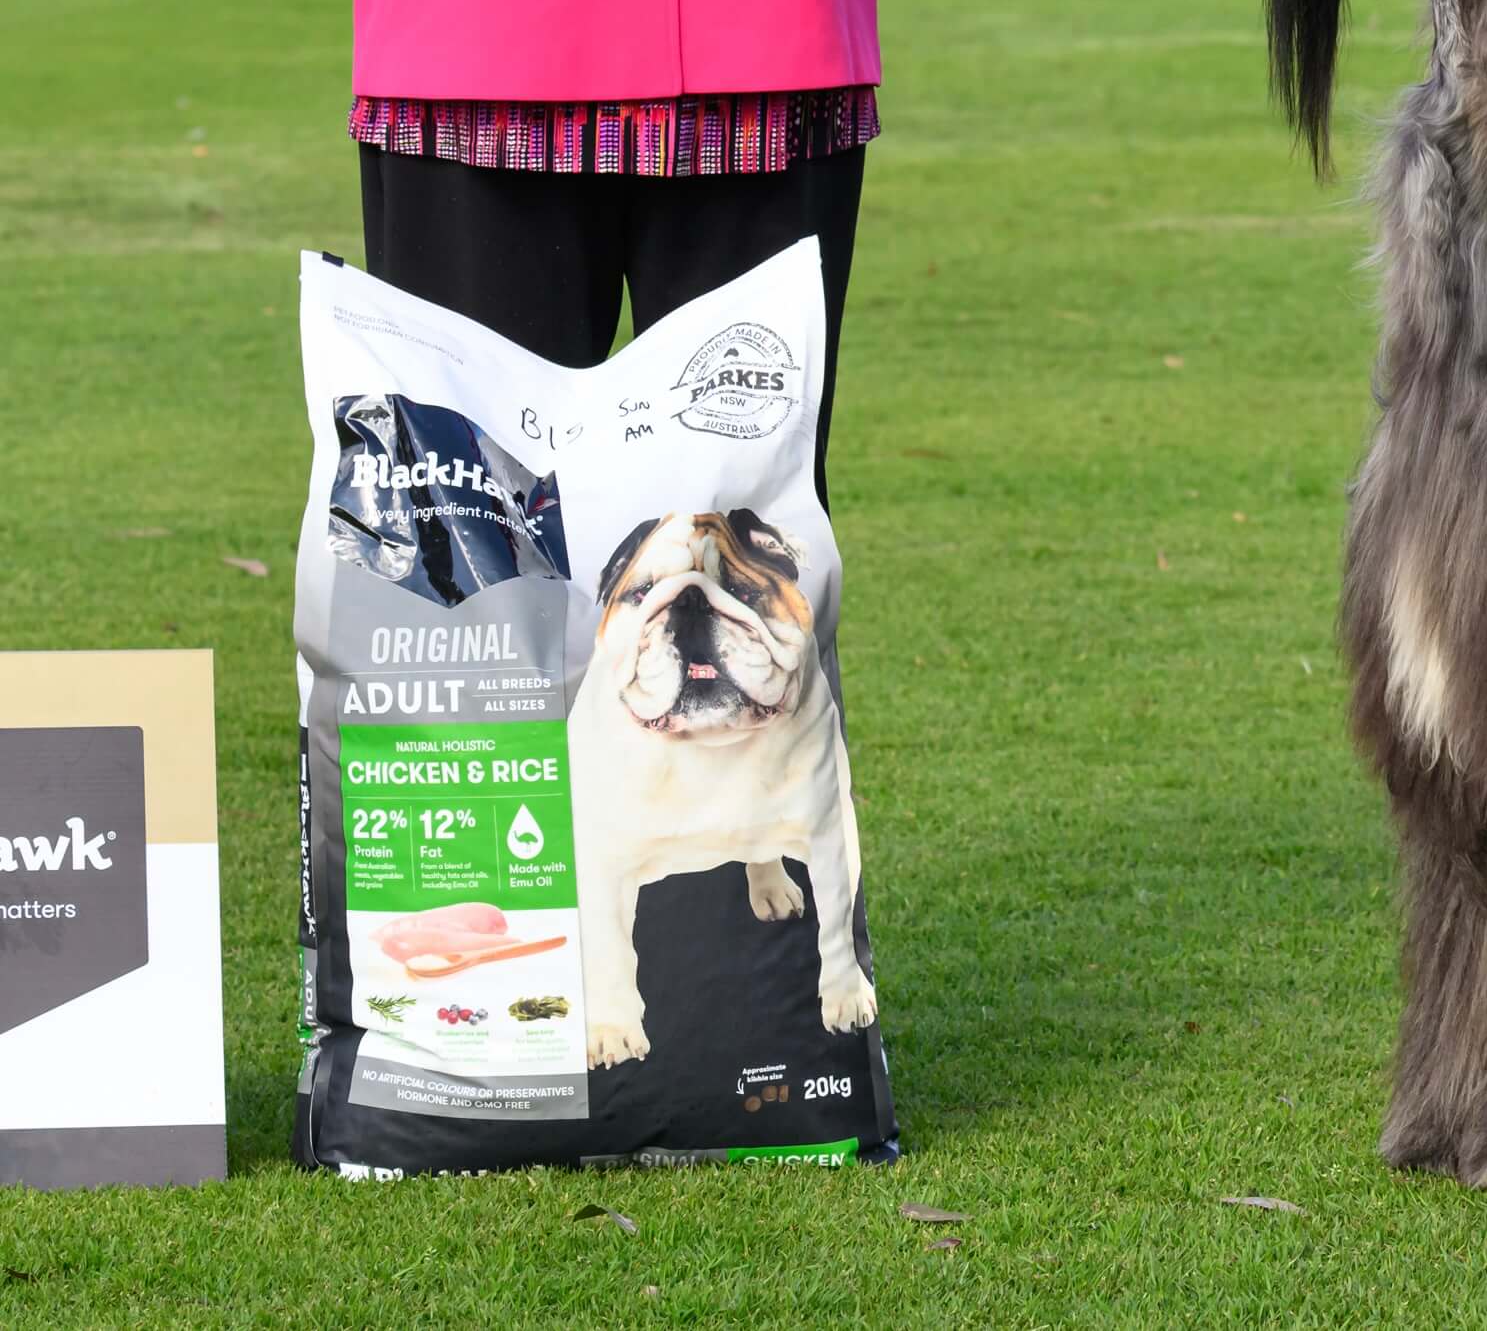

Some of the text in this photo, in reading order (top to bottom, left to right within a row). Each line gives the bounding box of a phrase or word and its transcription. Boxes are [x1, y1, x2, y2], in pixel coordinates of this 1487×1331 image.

[735, 328, 769, 346] MADE
[769, 342, 782, 355] IN
[690, 368, 785, 404] PARKES
[720, 396, 747, 407] NSW
[703, 420, 761, 434] AUSTRALIA
[412, 502, 481, 522] ingredient
[371, 623, 518, 664] ORIGINAL
[477, 677, 551, 690] ALL BREEDS
[343, 680, 465, 714] ADULT
[484, 699, 546, 712] ALL SIZES
[396, 739, 496, 753] NATURAL HOLISTIC
[347, 758, 559, 784] CHICKEN & RICE
[352, 808, 408, 839] 22%
[419, 808, 476, 839] 12%
[354, 844, 394, 858] Protein
[420, 846, 443, 859] Fat
[509, 862, 566, 874] Made with
[510, 877, 553, 888] Emu Oil
[362, 1070, 575, 1099] NO ARTIFICIAL COLOURS OR PRESERVATIVES
[803, 1075, 852, 1100] 20kg
[397, 1089, 531, 1110] HORMONE AND GMO FREE
